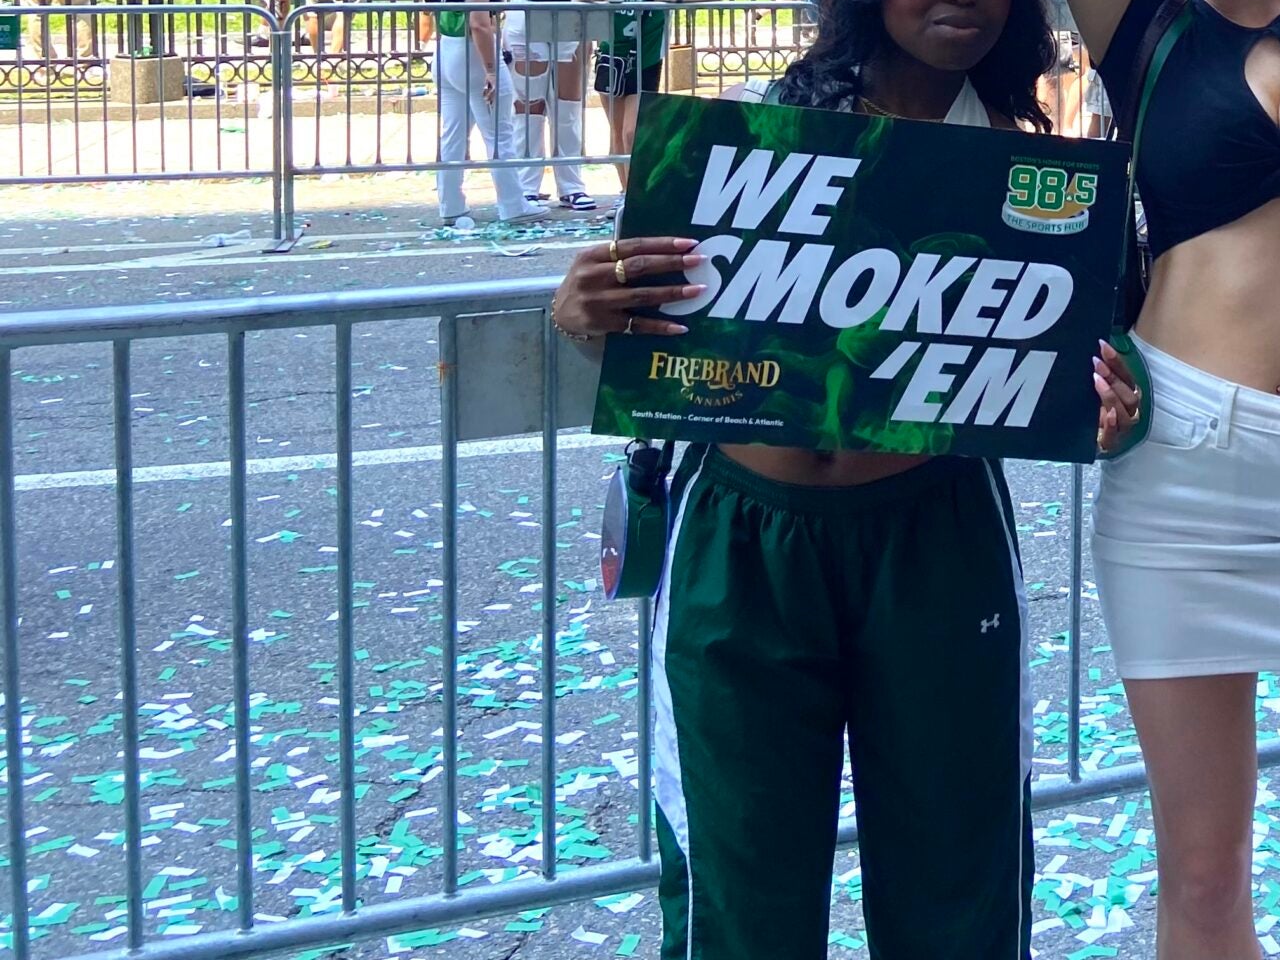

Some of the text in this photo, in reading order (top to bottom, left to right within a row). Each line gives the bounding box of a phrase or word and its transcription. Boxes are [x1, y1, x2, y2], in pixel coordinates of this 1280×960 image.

[690, 144, 862, 236] WE
[1007, 164, 1098, 211] 98.5
[1007, 214, 1024, 227] THE
[1027, 220, 1063, 232] SPORTS
[659, 235, 1074, 340] SMOKED
[648, 351, 781, 390] FIREBRAND
[680, 387, 744, 407] CANNABIS
[631, 409, 653, 419] South
[654, 411, 682, 421] Station
[688, 414, 713, 423] Corner
[715, 415, 724, 423] of
[725, 416, 748, 425] Beach
[755, 418, 784, 427] Atlantic
